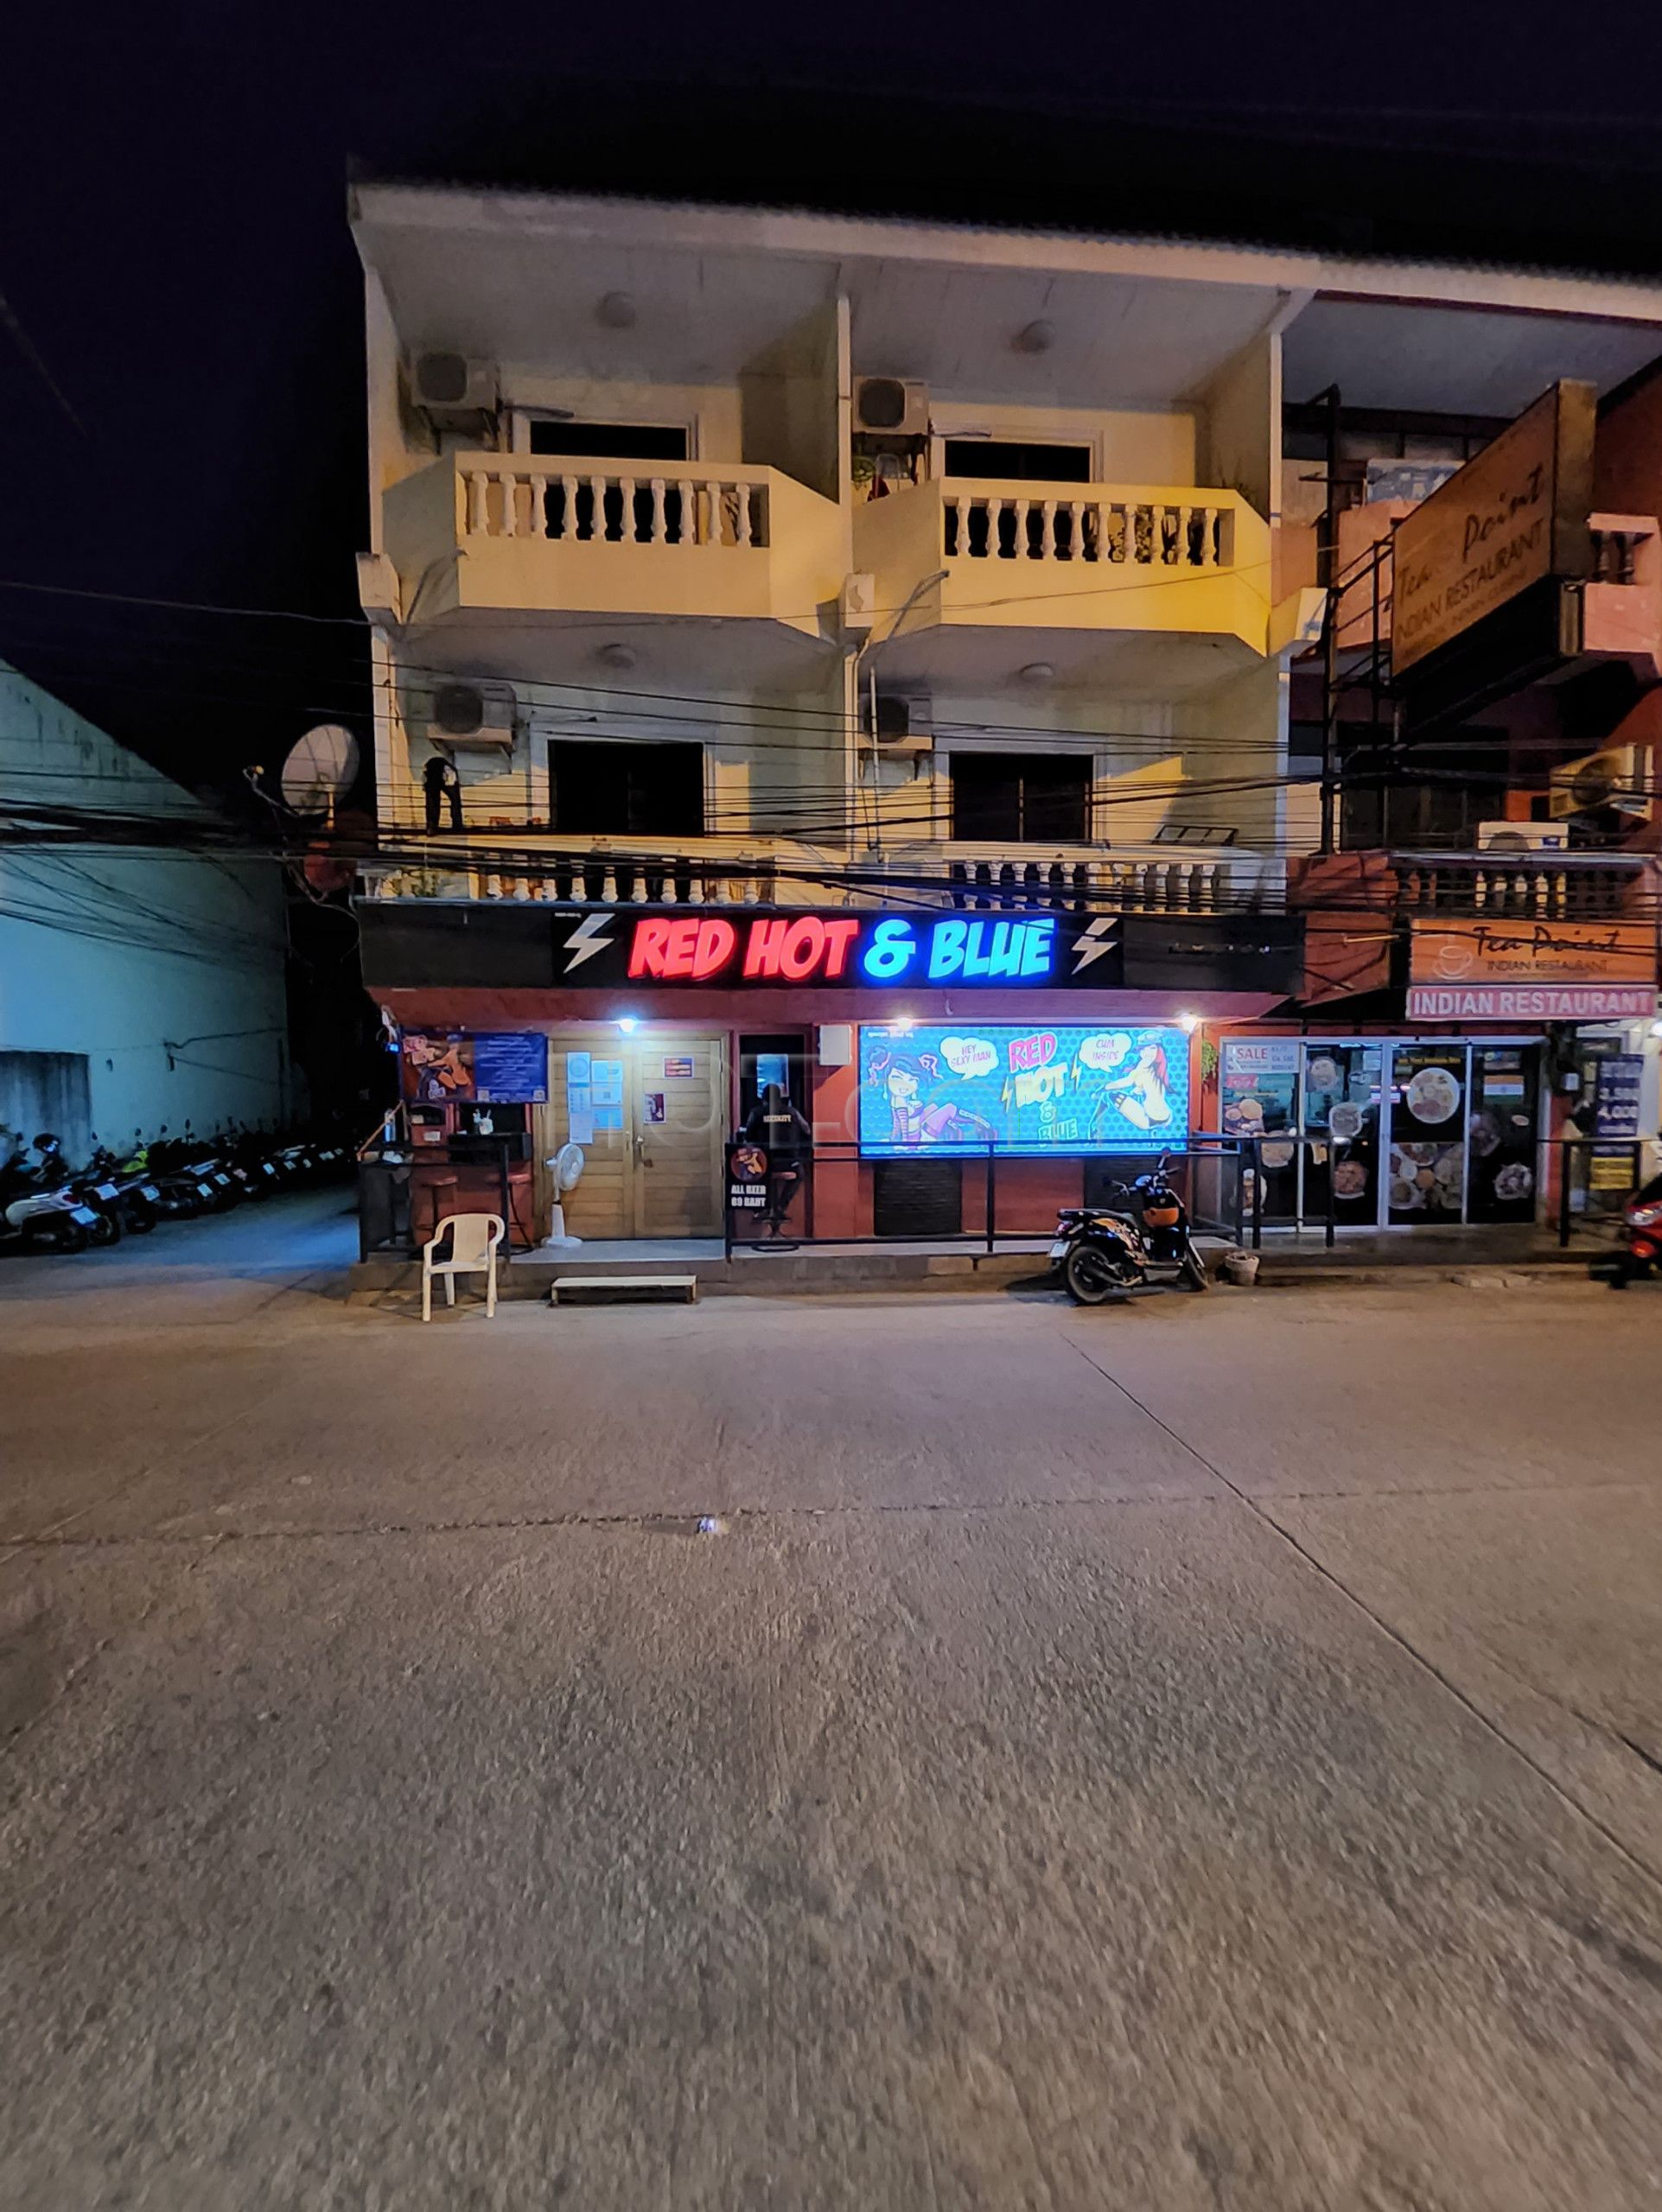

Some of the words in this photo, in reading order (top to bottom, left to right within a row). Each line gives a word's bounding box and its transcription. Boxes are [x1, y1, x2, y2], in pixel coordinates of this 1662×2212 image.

[1446, 518, 1546, 610] RESTAURANT
[627, 917, 736, 981] RED
[742, 916, 860, 982] HOT
[863, 918, 916, 978] &
[927, 918, 1057, 979] BLUE
[1473, 926, 1519, 957] Tea
[1487, 960, 1531, 972] INDIAN
[1535, 959, 1608, 972] RESTAURANT
[1414, 993, 1493, 1015] INDIAN
[1500, 992, 1651, 1014] RESTAURANT
[962, 1044, 976, 1055] HEY
[1009, 1031, 1059, 1073] RED
[1093, 1052, 1119, 1061] INSIDE
[1237, 1048, 1268, 1060] SALE
[951, 1055, 971, 1067] SEXY
[1015, 1062, 1068, 1109] HOT
[1039, 1101, 1057, 1123] &
[1038, 1117, 1079, 1145] BLUE
[731, 1185, 745, 1195] ALL
